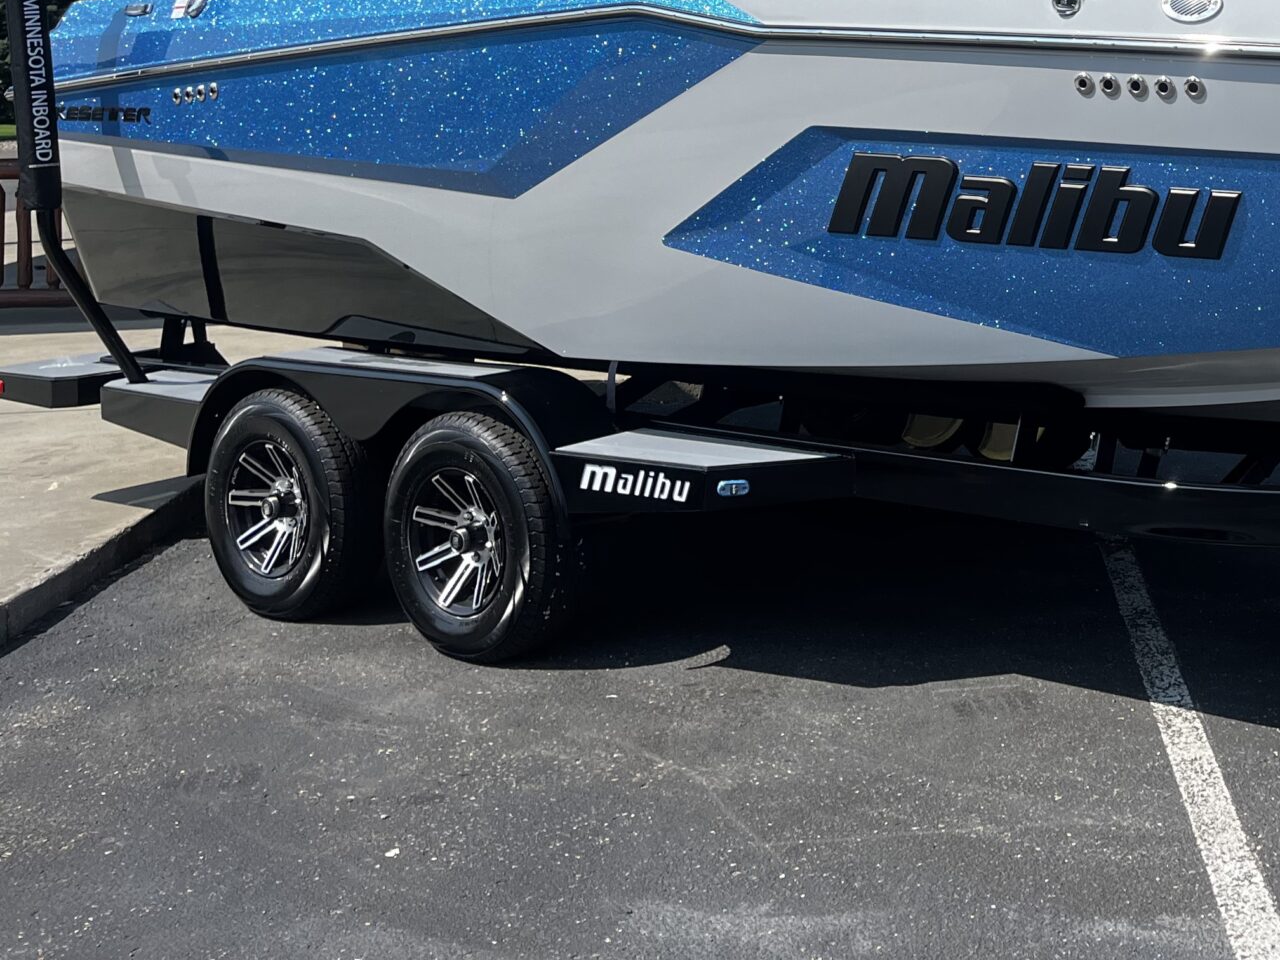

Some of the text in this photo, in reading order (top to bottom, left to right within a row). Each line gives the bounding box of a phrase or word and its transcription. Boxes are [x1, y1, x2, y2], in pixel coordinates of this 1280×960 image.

[31, 90, 53, 163] INBOARD
[826, 151, 1243, 260] Malibu
[579, 463, 691, 503] Malibu
